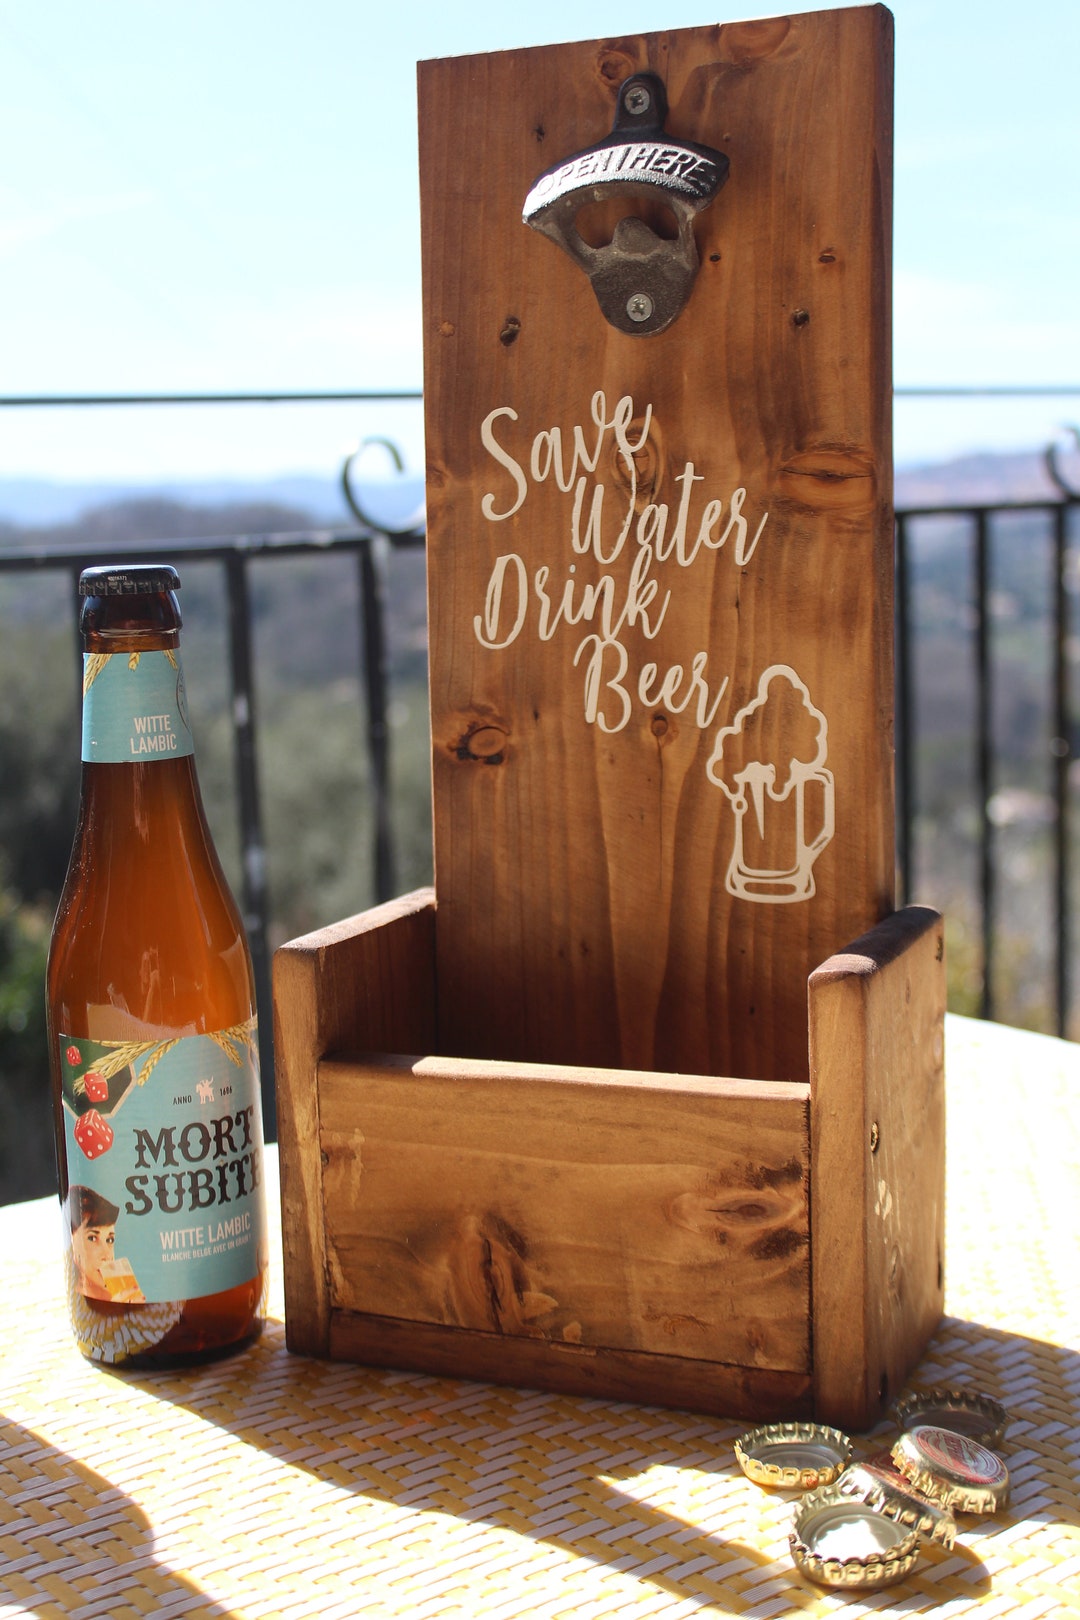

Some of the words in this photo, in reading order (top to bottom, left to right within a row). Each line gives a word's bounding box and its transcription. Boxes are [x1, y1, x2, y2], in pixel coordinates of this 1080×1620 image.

[538, 148, 617, 197] OPEN
[627, 146, 717, 182] HERE
[480, 390, 652, 521] Save
[571, 449, 769, 567] Water
[473, 544, 671, 649] Drink
[573, 634, 729, 733] Beer
[130, 733, 177, 754] LAMBIC
[134, 714, 171, 734] WITTE
[173, 1095, 192, 1105] ANNO
[132, 1105, 254, 1169] MORT
[159, 1226, 205, 1250] WITTE
[208, 1212, 251, 1244] LAMBIC
[162, 1250, 192, 1263] BLANCHE
[192, 1246, 213, 1259] BELGE
[213, 1242, 227, 1255] AVEC
